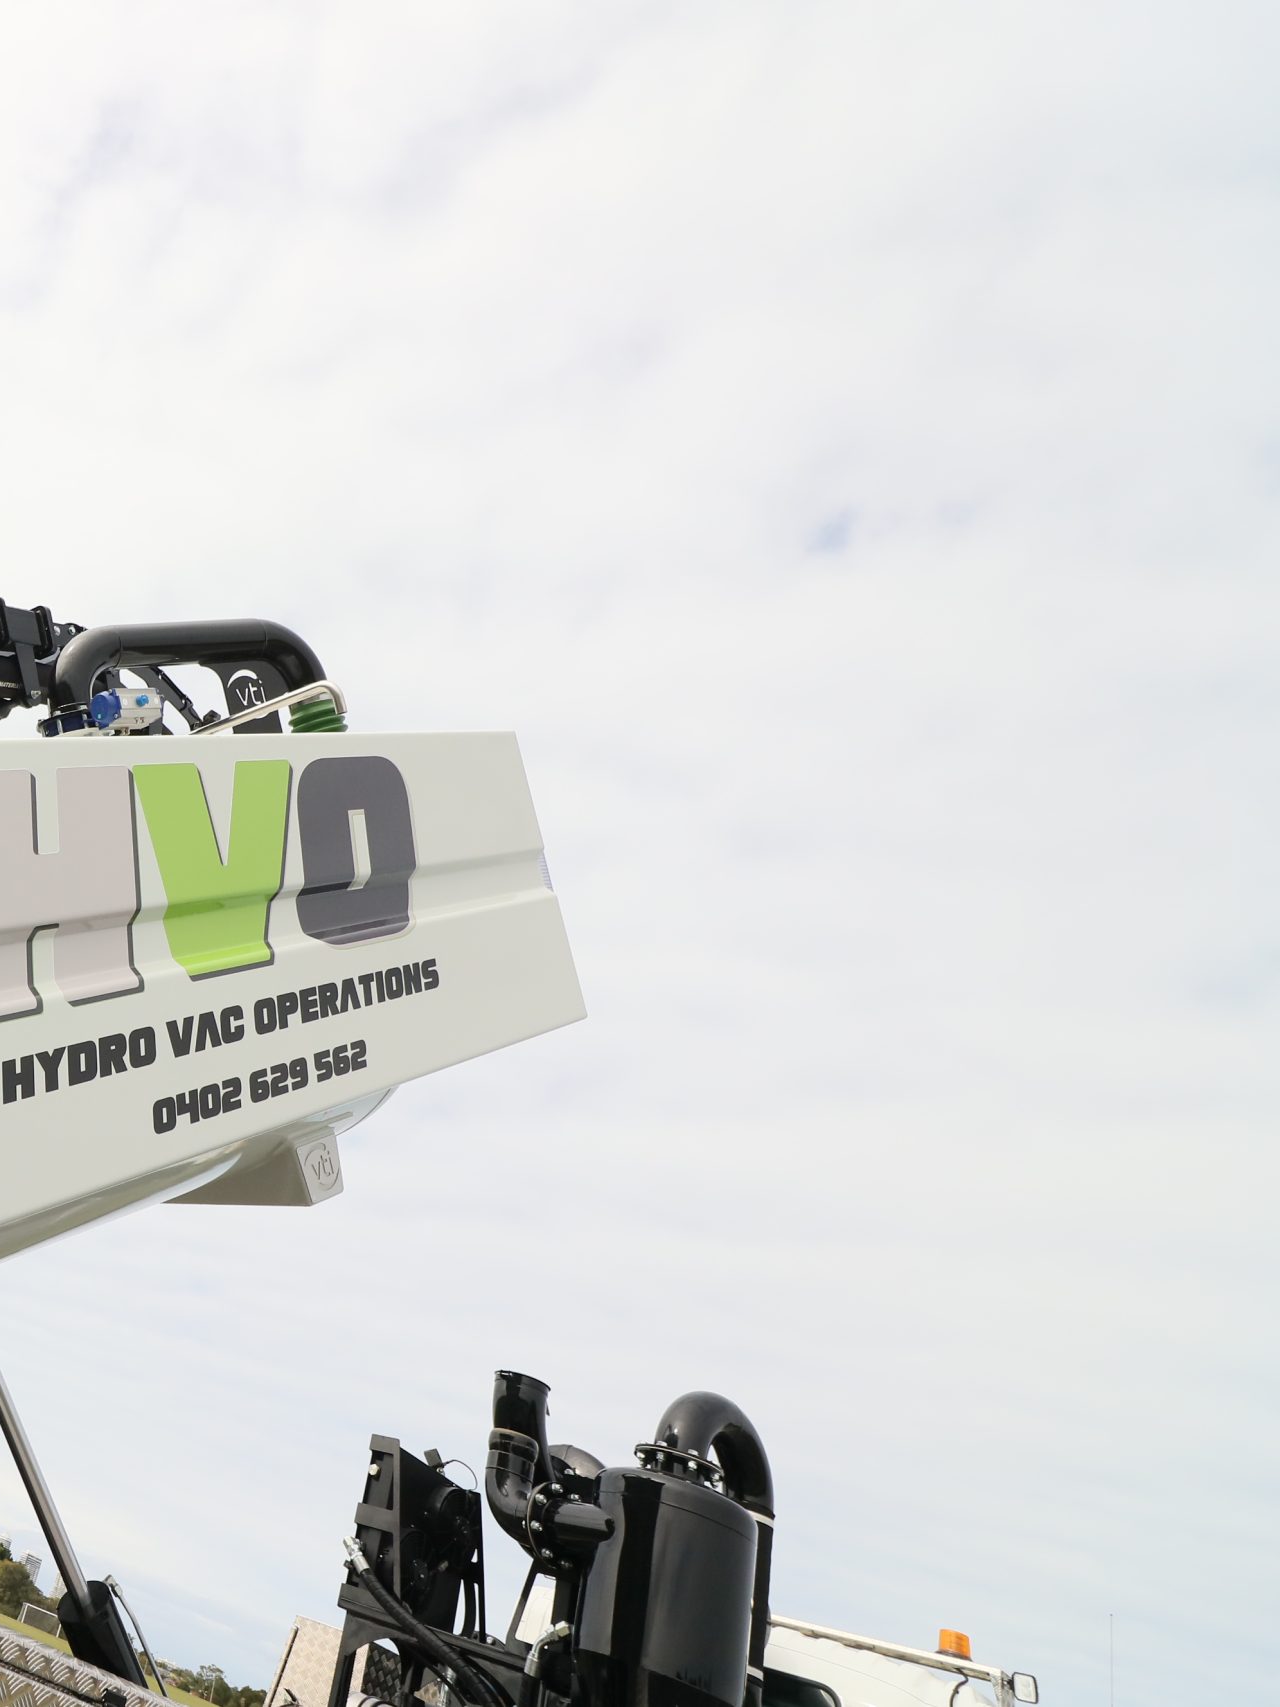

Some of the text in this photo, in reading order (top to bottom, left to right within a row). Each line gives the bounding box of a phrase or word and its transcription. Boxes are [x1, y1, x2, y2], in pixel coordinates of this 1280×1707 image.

[235, 680, 267, 706] vti
[2, 958, 440, 1104] HYDRO VAC OPERATIONS
[153, 1039, 367, 1134] 0402 629 562
[311, 1150, 335, 1180] vti
